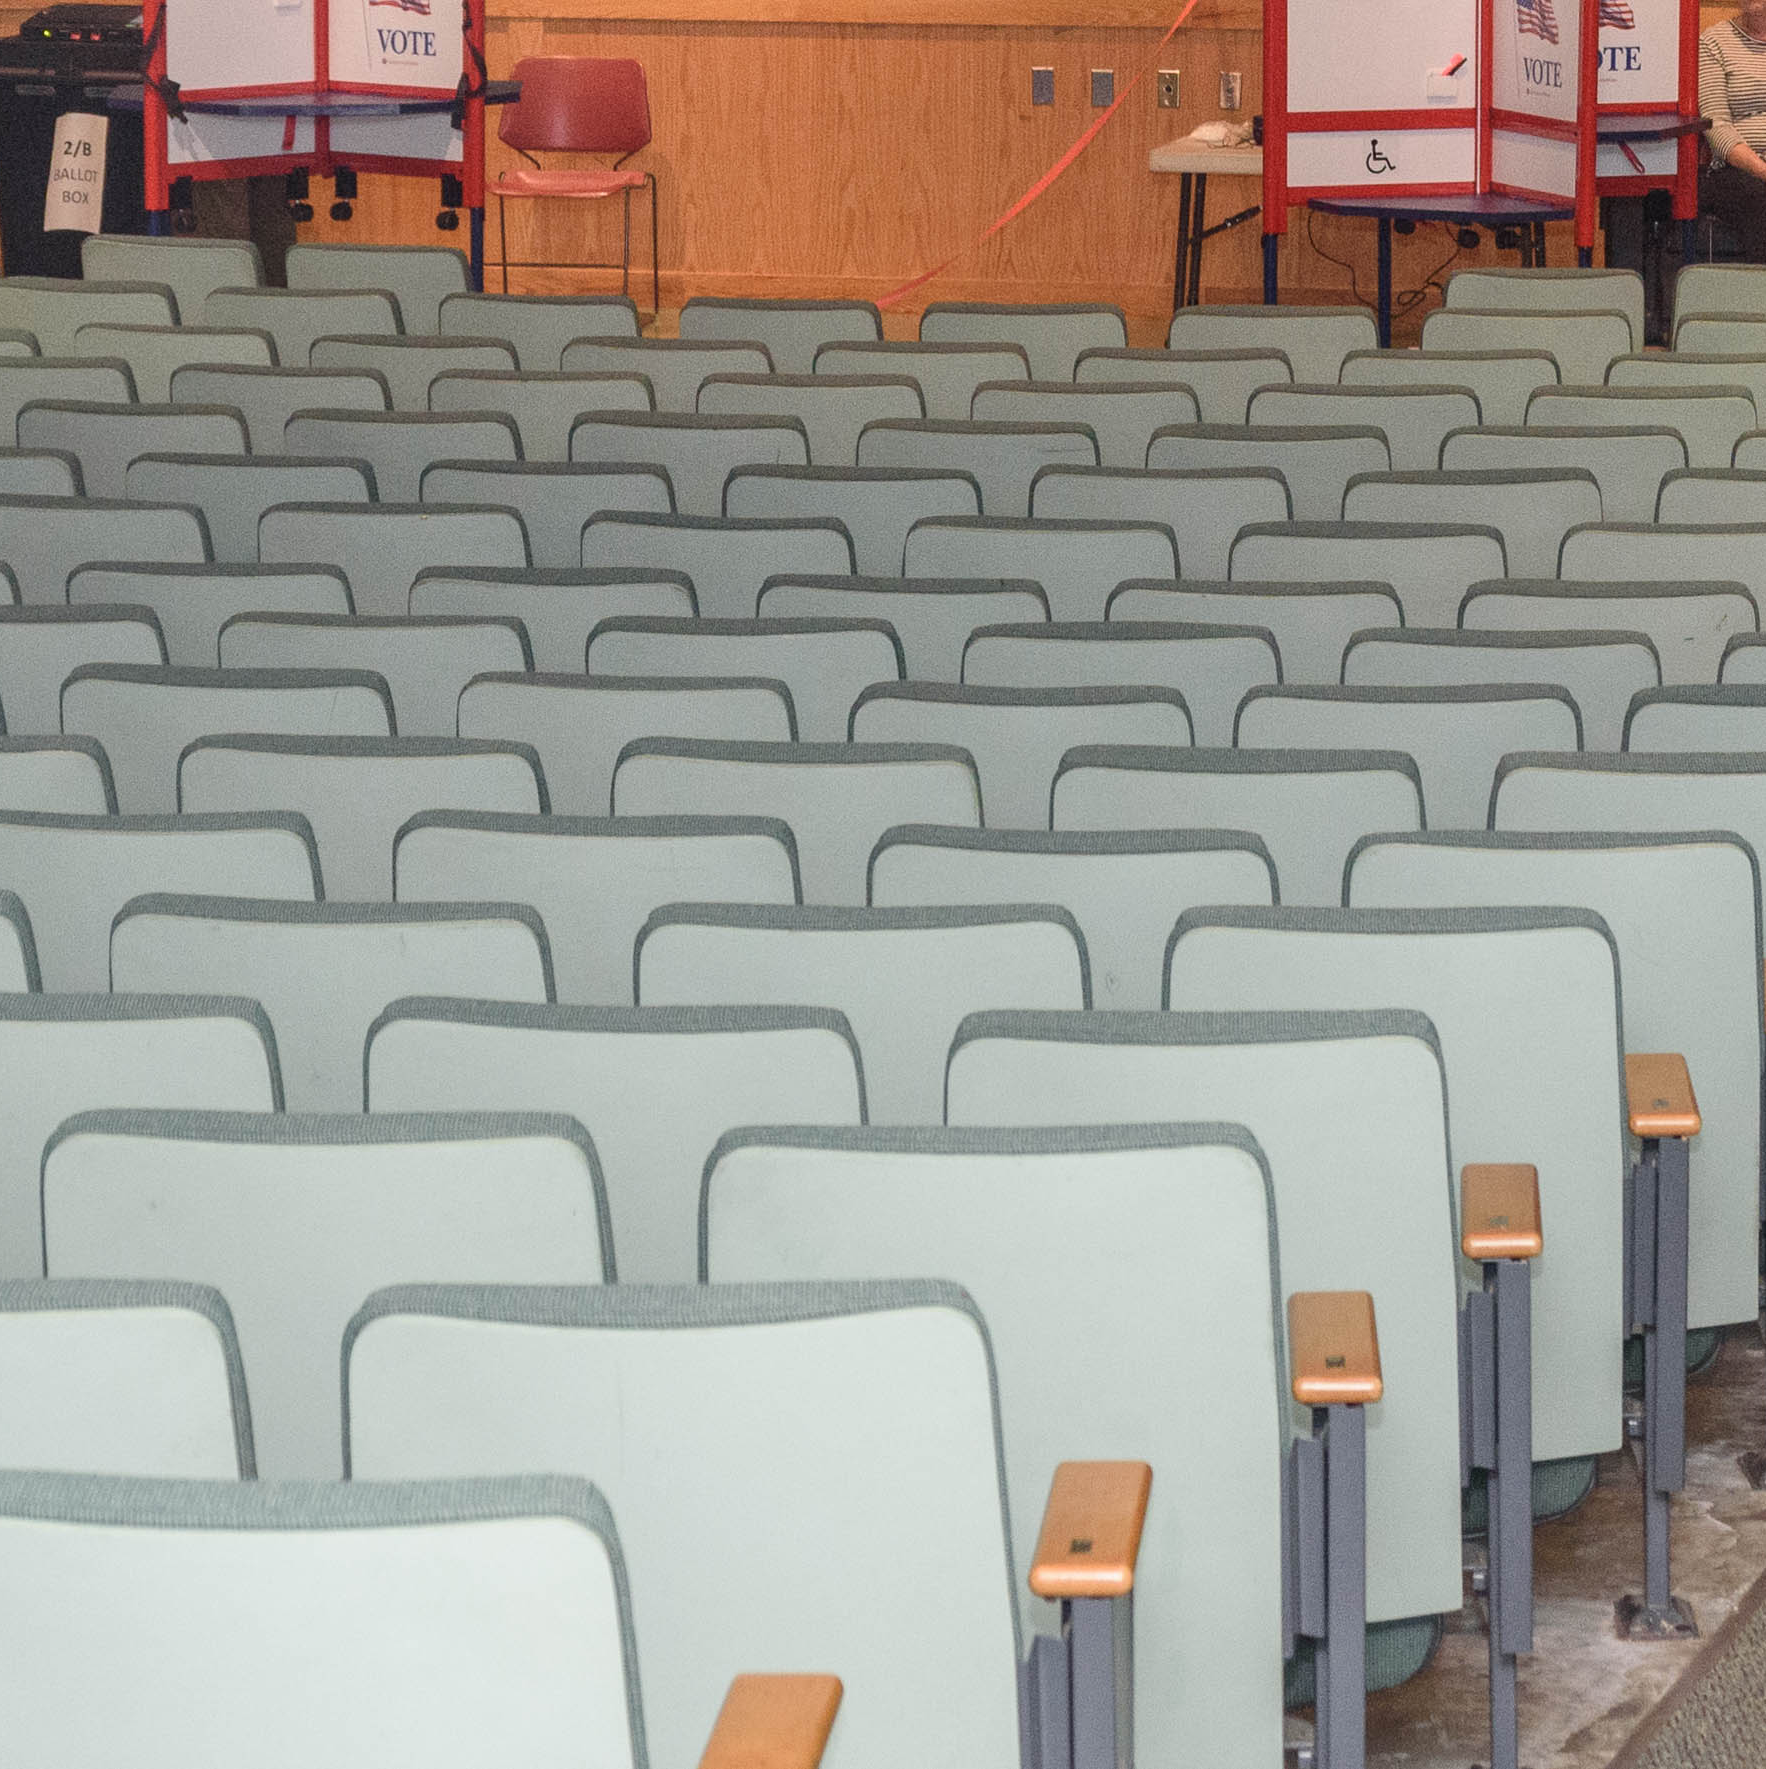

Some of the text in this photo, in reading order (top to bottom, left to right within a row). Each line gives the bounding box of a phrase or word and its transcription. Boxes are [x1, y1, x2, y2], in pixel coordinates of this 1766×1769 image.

[377, 28, 437, 56] VOTE
[1597, 46, 1642, 71] TE
[1523, 57, 1563, 88] VOTE
[63, 140, 92, 158] 2/B
[53, 168, 98, 183] BALLOT
[62, 191, 89, 204] BOX
